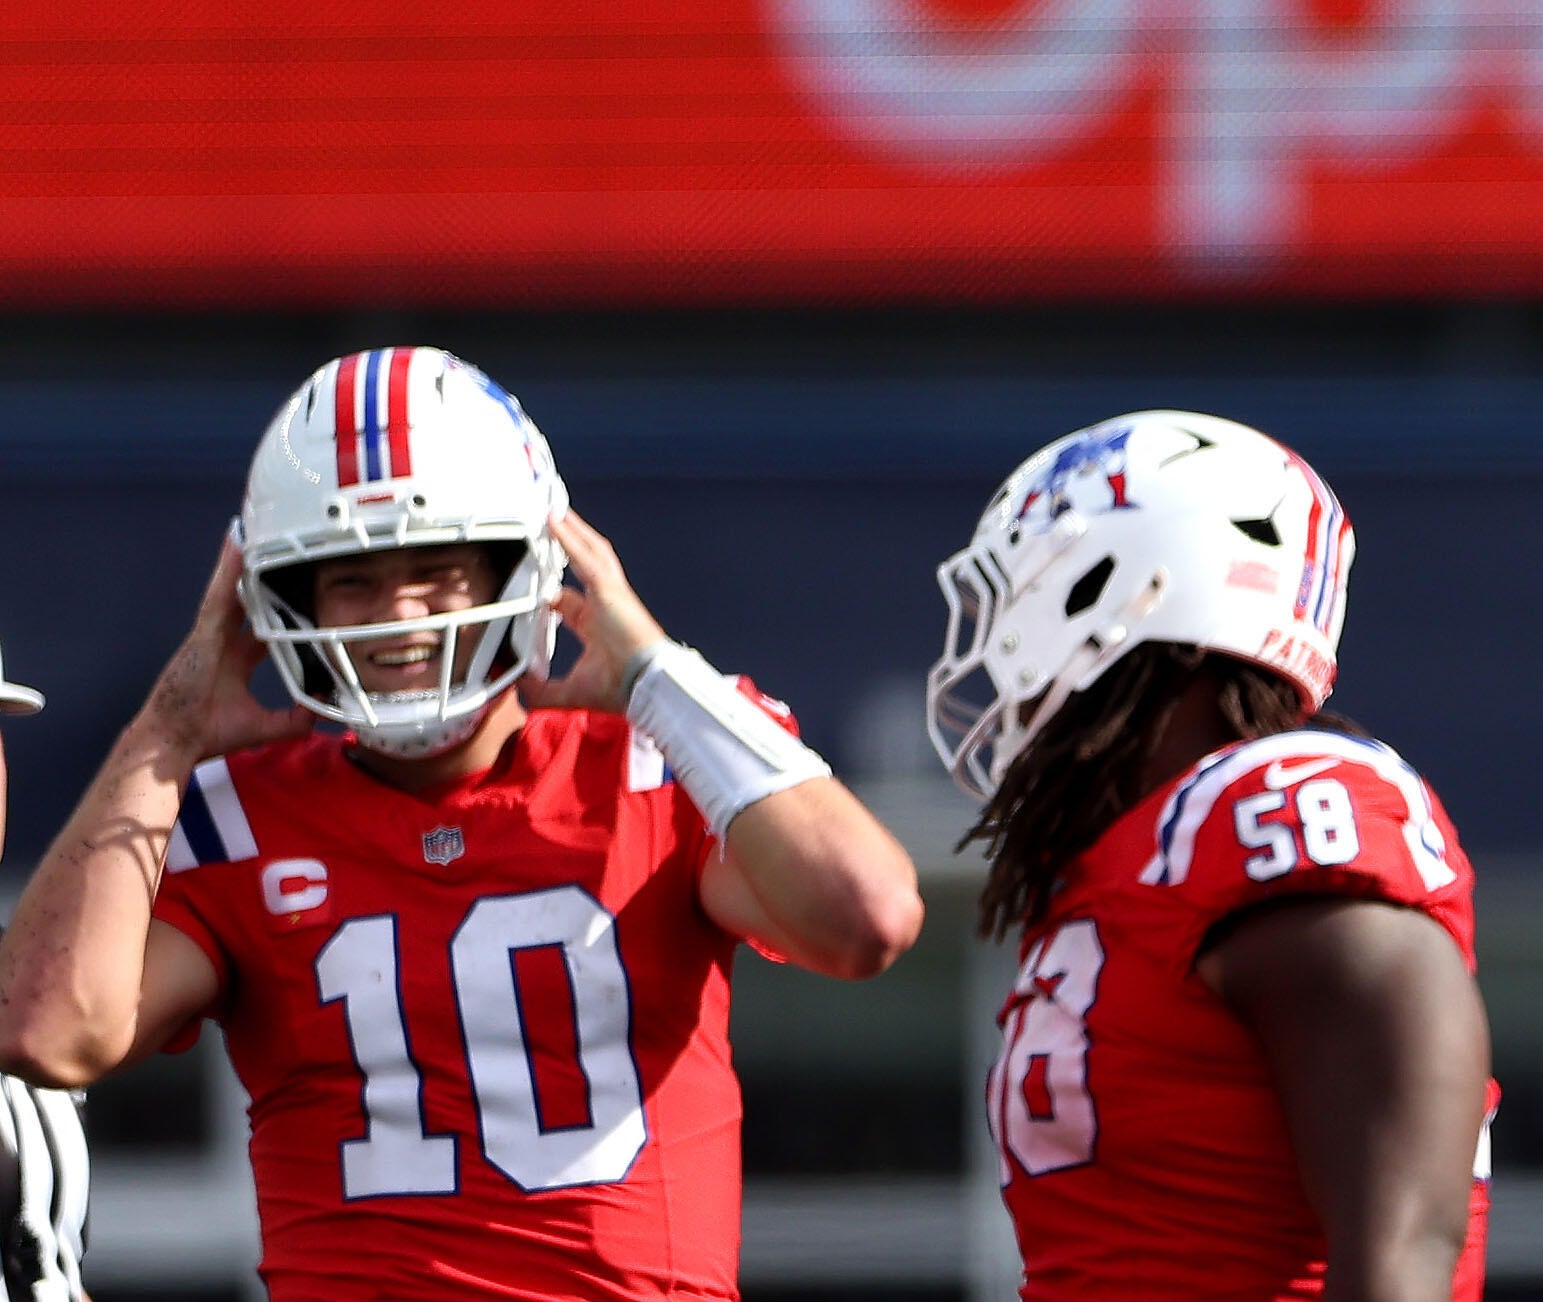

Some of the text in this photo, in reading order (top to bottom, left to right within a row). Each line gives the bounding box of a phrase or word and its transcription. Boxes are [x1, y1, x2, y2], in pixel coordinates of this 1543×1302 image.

[1234, 778, 1361, 882] 58
[261, 857, 329, 916] C
[314, 882, 648, 1202] 10
